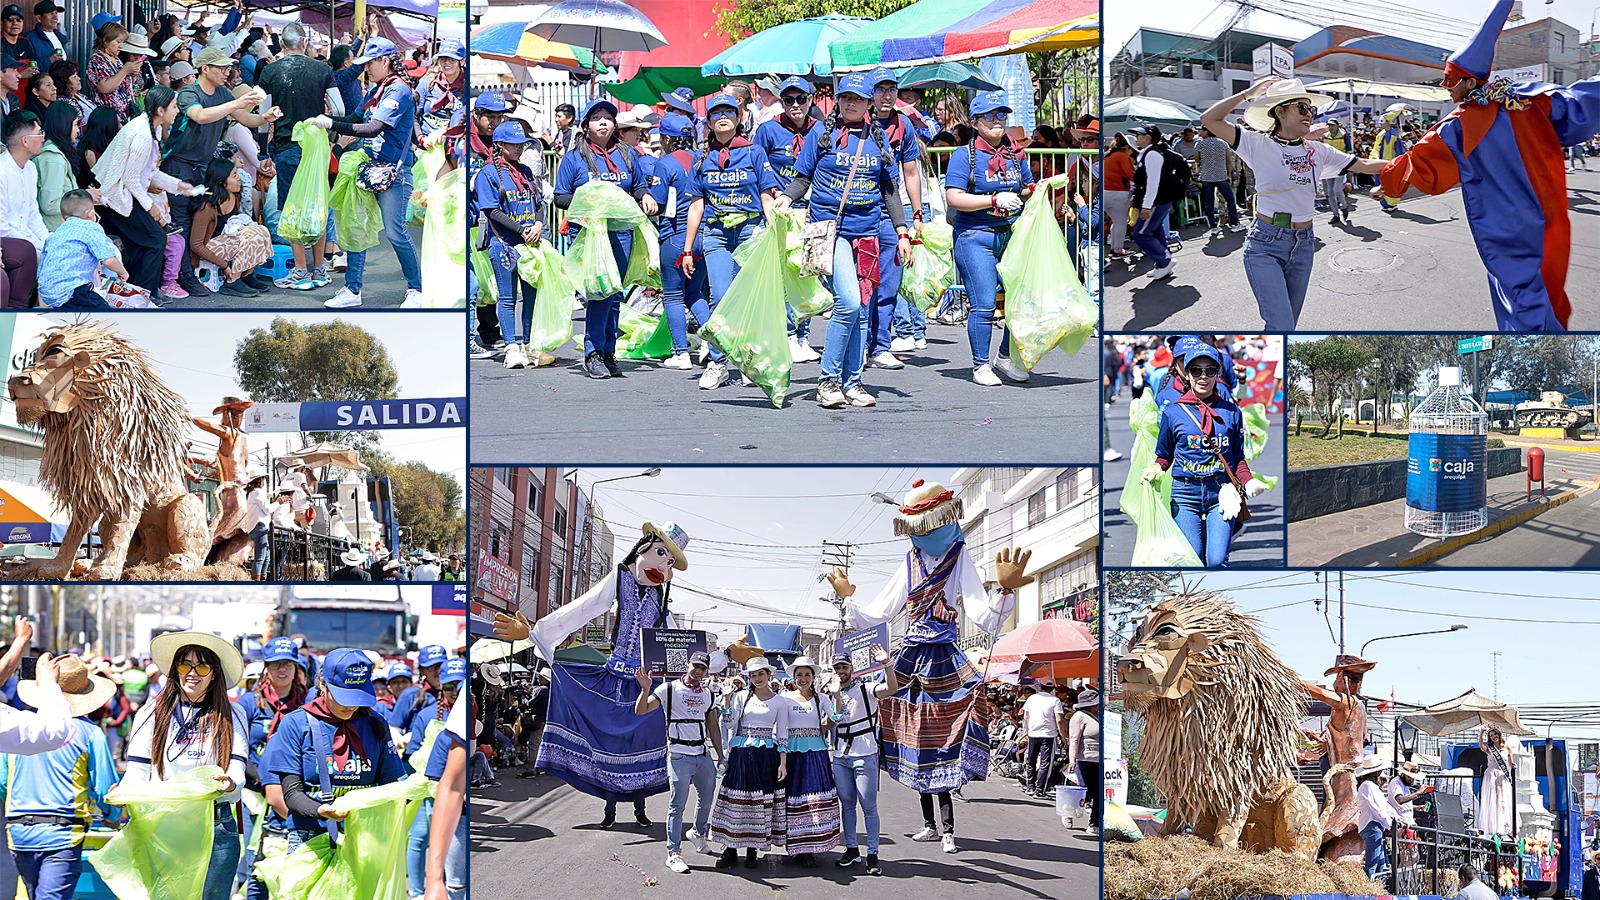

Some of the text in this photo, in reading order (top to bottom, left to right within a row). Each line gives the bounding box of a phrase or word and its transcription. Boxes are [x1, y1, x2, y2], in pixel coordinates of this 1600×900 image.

[720, 169, 748, 182] caja
[337, 402, 461, 426] SALIDA
[1202, 433, 1229, 447] caja
[1444, 459, 1474, 475] caja
